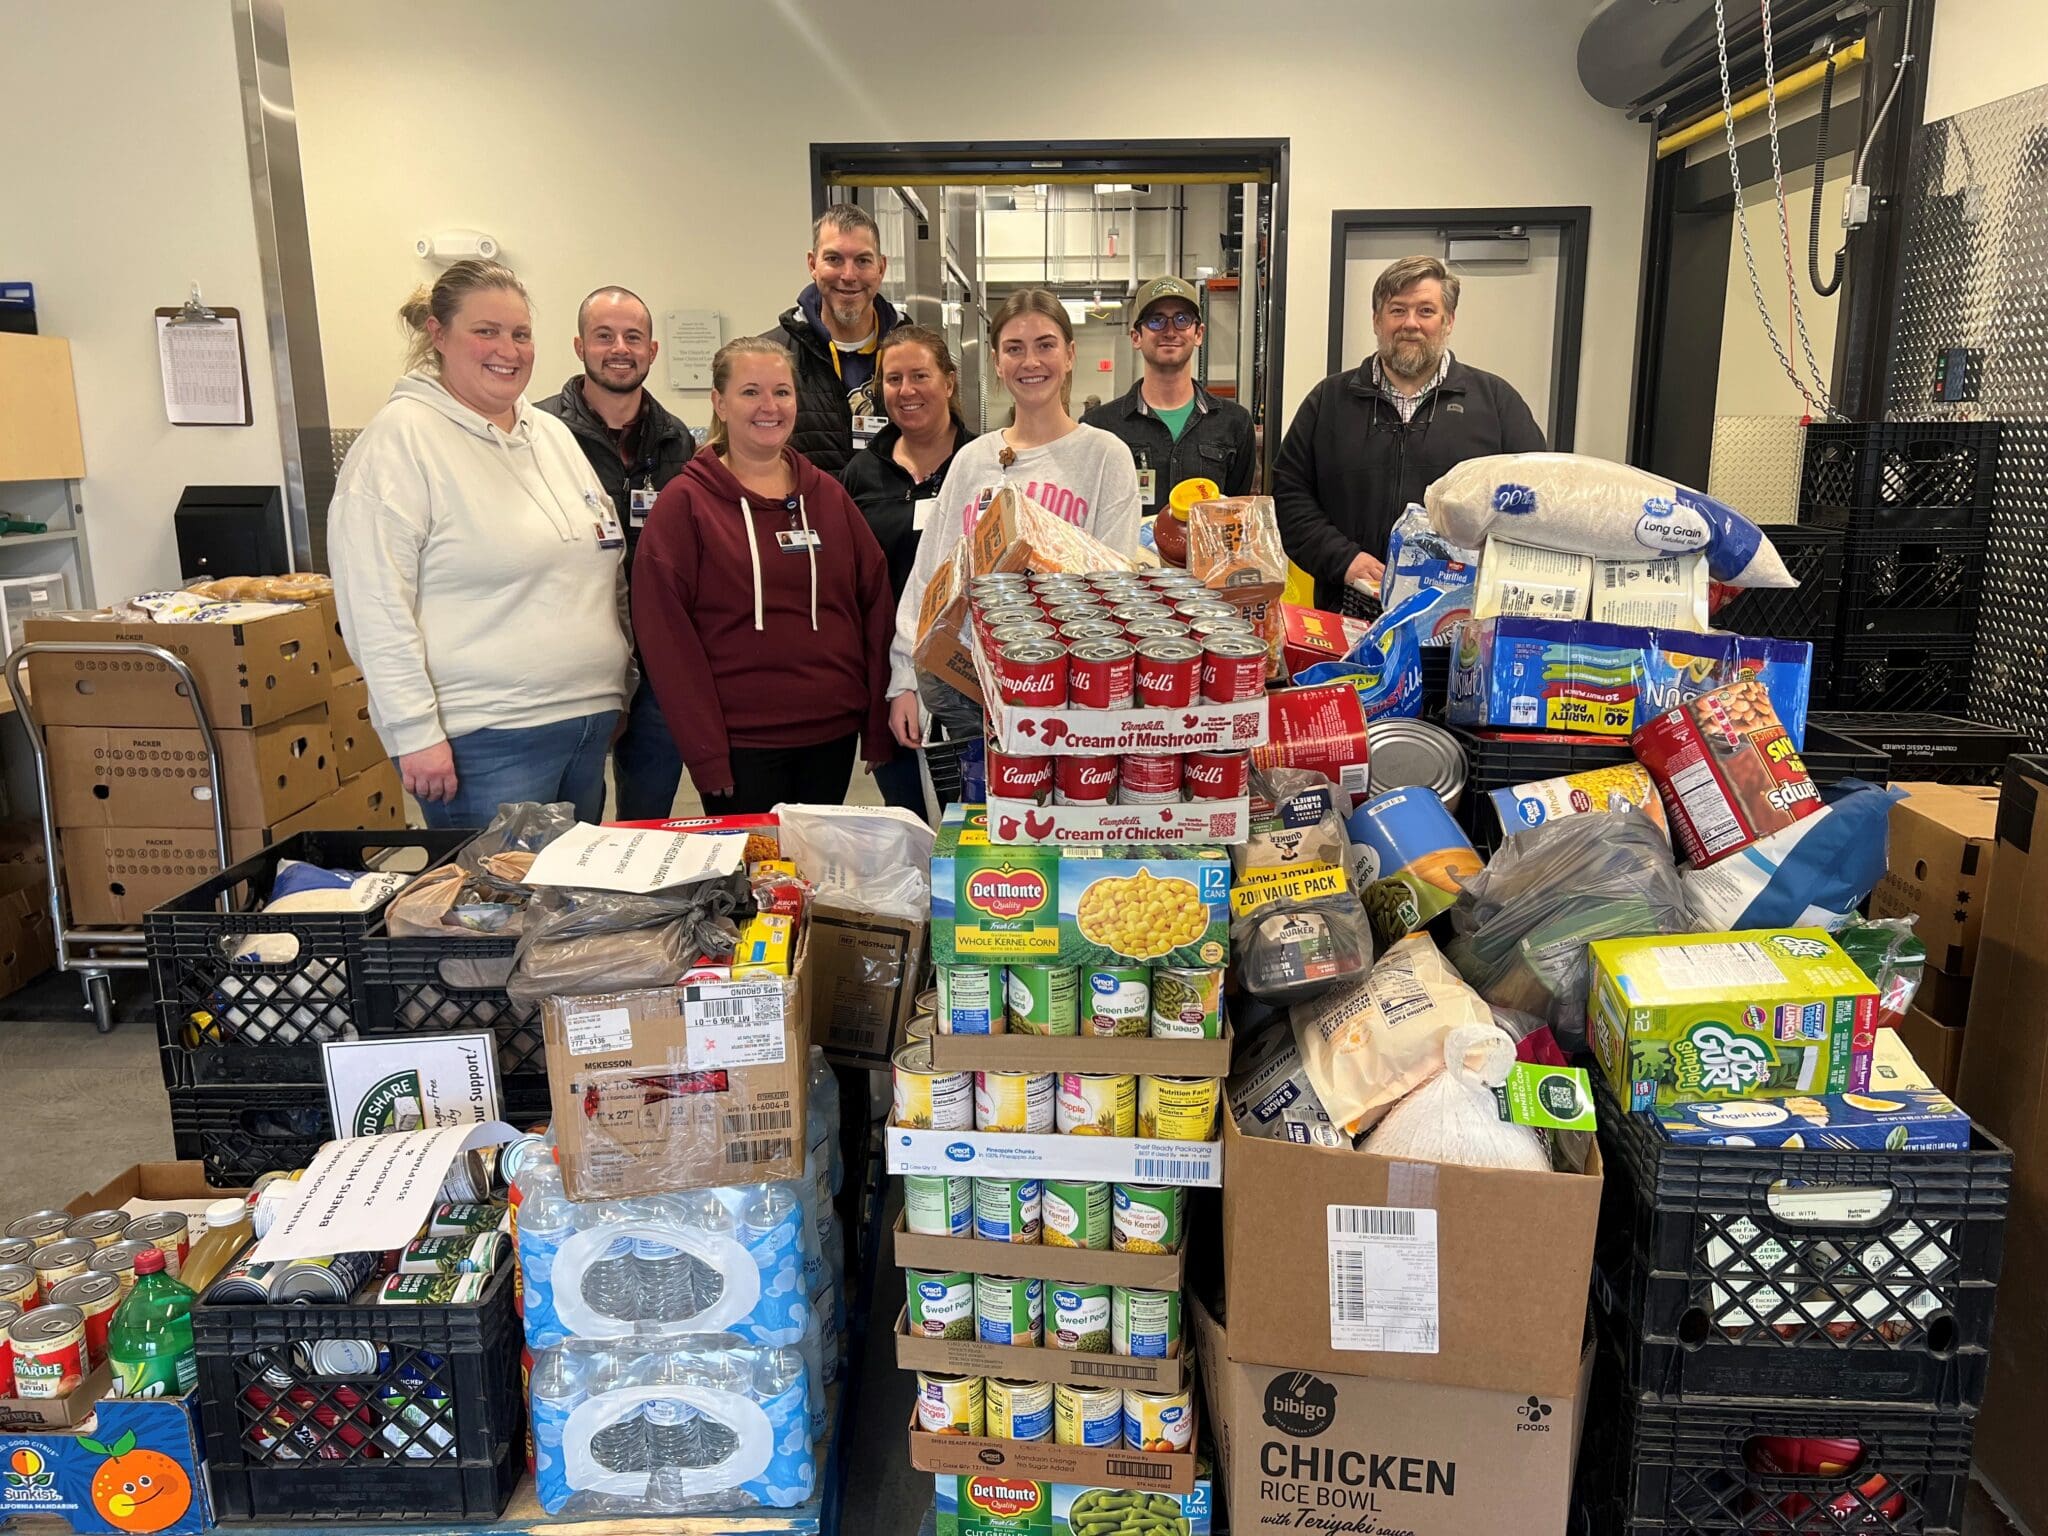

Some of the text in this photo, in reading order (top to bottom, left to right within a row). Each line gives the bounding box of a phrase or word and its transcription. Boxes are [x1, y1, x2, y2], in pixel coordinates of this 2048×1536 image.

[1644, 521, 1702, 539] Long Grain
[1438, 570, 1467, 584] Purified
[1605, 693, 1619, 702] 20
[1560, 703, 1587, 713] PACK
[1551, 711, 1595, 723] VARIETY
[1604, 713, 1628, 726] 40
[1121, 721, 1165, 731] Campbell's
[1065, 731, 1218, 748] Cream of Mushroom
[1293, 802, 1321, 811] FLAVOR
[1099, 816, 1141, 826] Campbell's
[1055, 826, 1183, 841] Cream of Chicken
[1270, 832, 1302, 843] QUAKER
[1205, 869, 1223, 888] 12
[972, 883, 1041, 898] Del Monte
[1204, 889, 1226, 898] CANS
[1239, 876, 1337, 906] 20 VALUE PACK
[992, 901, 1021, 912] Quality
[1280, 926, 1314, 939] QUAKER
[1092, 977, 1114, 987] Great
[1096, 1005, 1122, 1015] Green
[1381, 1001, 1391, 1010] 90
[1388, 1003, 1433, 1026] Nutrition Facts
[1634, 1010, 1650, 1032] 32
[1174, 1025, 1200, 1033] Green
[1723, 1038, 1765, 1080] GO
[1232, 1047, 1296, 1104] PHILADELPHIA
[1511, 1080, 1519, 1090] TO
[1159, 1087, 1190, 1095] Nutrition
[372, 1078, 413, 1118] SHARE
[1260, 1089, 1293, 1118] 6 PACKS
[1159, 1108, 1183, 1116] Calories
[1712, 1110, 1779, 1121] Angel Hair
[949, 1146, 970, 1156] Great
[1134, 1143, 1212, 1154] Shelf Ready Packaging
[317, 1140, 378, 1230] BENEFIS HELENA
[363, 1154, 399, 1209] 25 MEDICAL
[283, 1147, 346, 1237] HELENA FOOD SHARE
[395, 1178, 415, 1203] 3510
[1134, 1219, 1160, 1230] Kernel
[920, 1284, 942, 1293] Great
[1054, 1293, 1077, 1302] Great
[925, 1304, 952, 1314] Sweet
[1059, 1314, 1088, 1325] Sweet
[1273, 1397, 1327, 1421] bibigo
[1517, 1405, 1531, 1416] CJ
[1516, 1423, 1550, 1432] FOODS
[1014, 1455, 1077, 1466] Mandarin Orange
[1028, 1463, 1048, 1472] Sugar
[1050, 1464, 1075, 1472] Added
[1260, 1441, 1456, 1496] CHICKEN
[4, 1487, 57, 1501] Sunkist
[973, 1485, 1036, 1501] Del Monte
[1260, 1480, 1382, 1512] RICE BOWL
[991, 1501, 1017, 1511] Quality
[1185, 1506, 1208, 1515] CANS
[1261, 1511, 1292, 1527] with
[1295, 1508, 1378, 1536] Teriyaki
